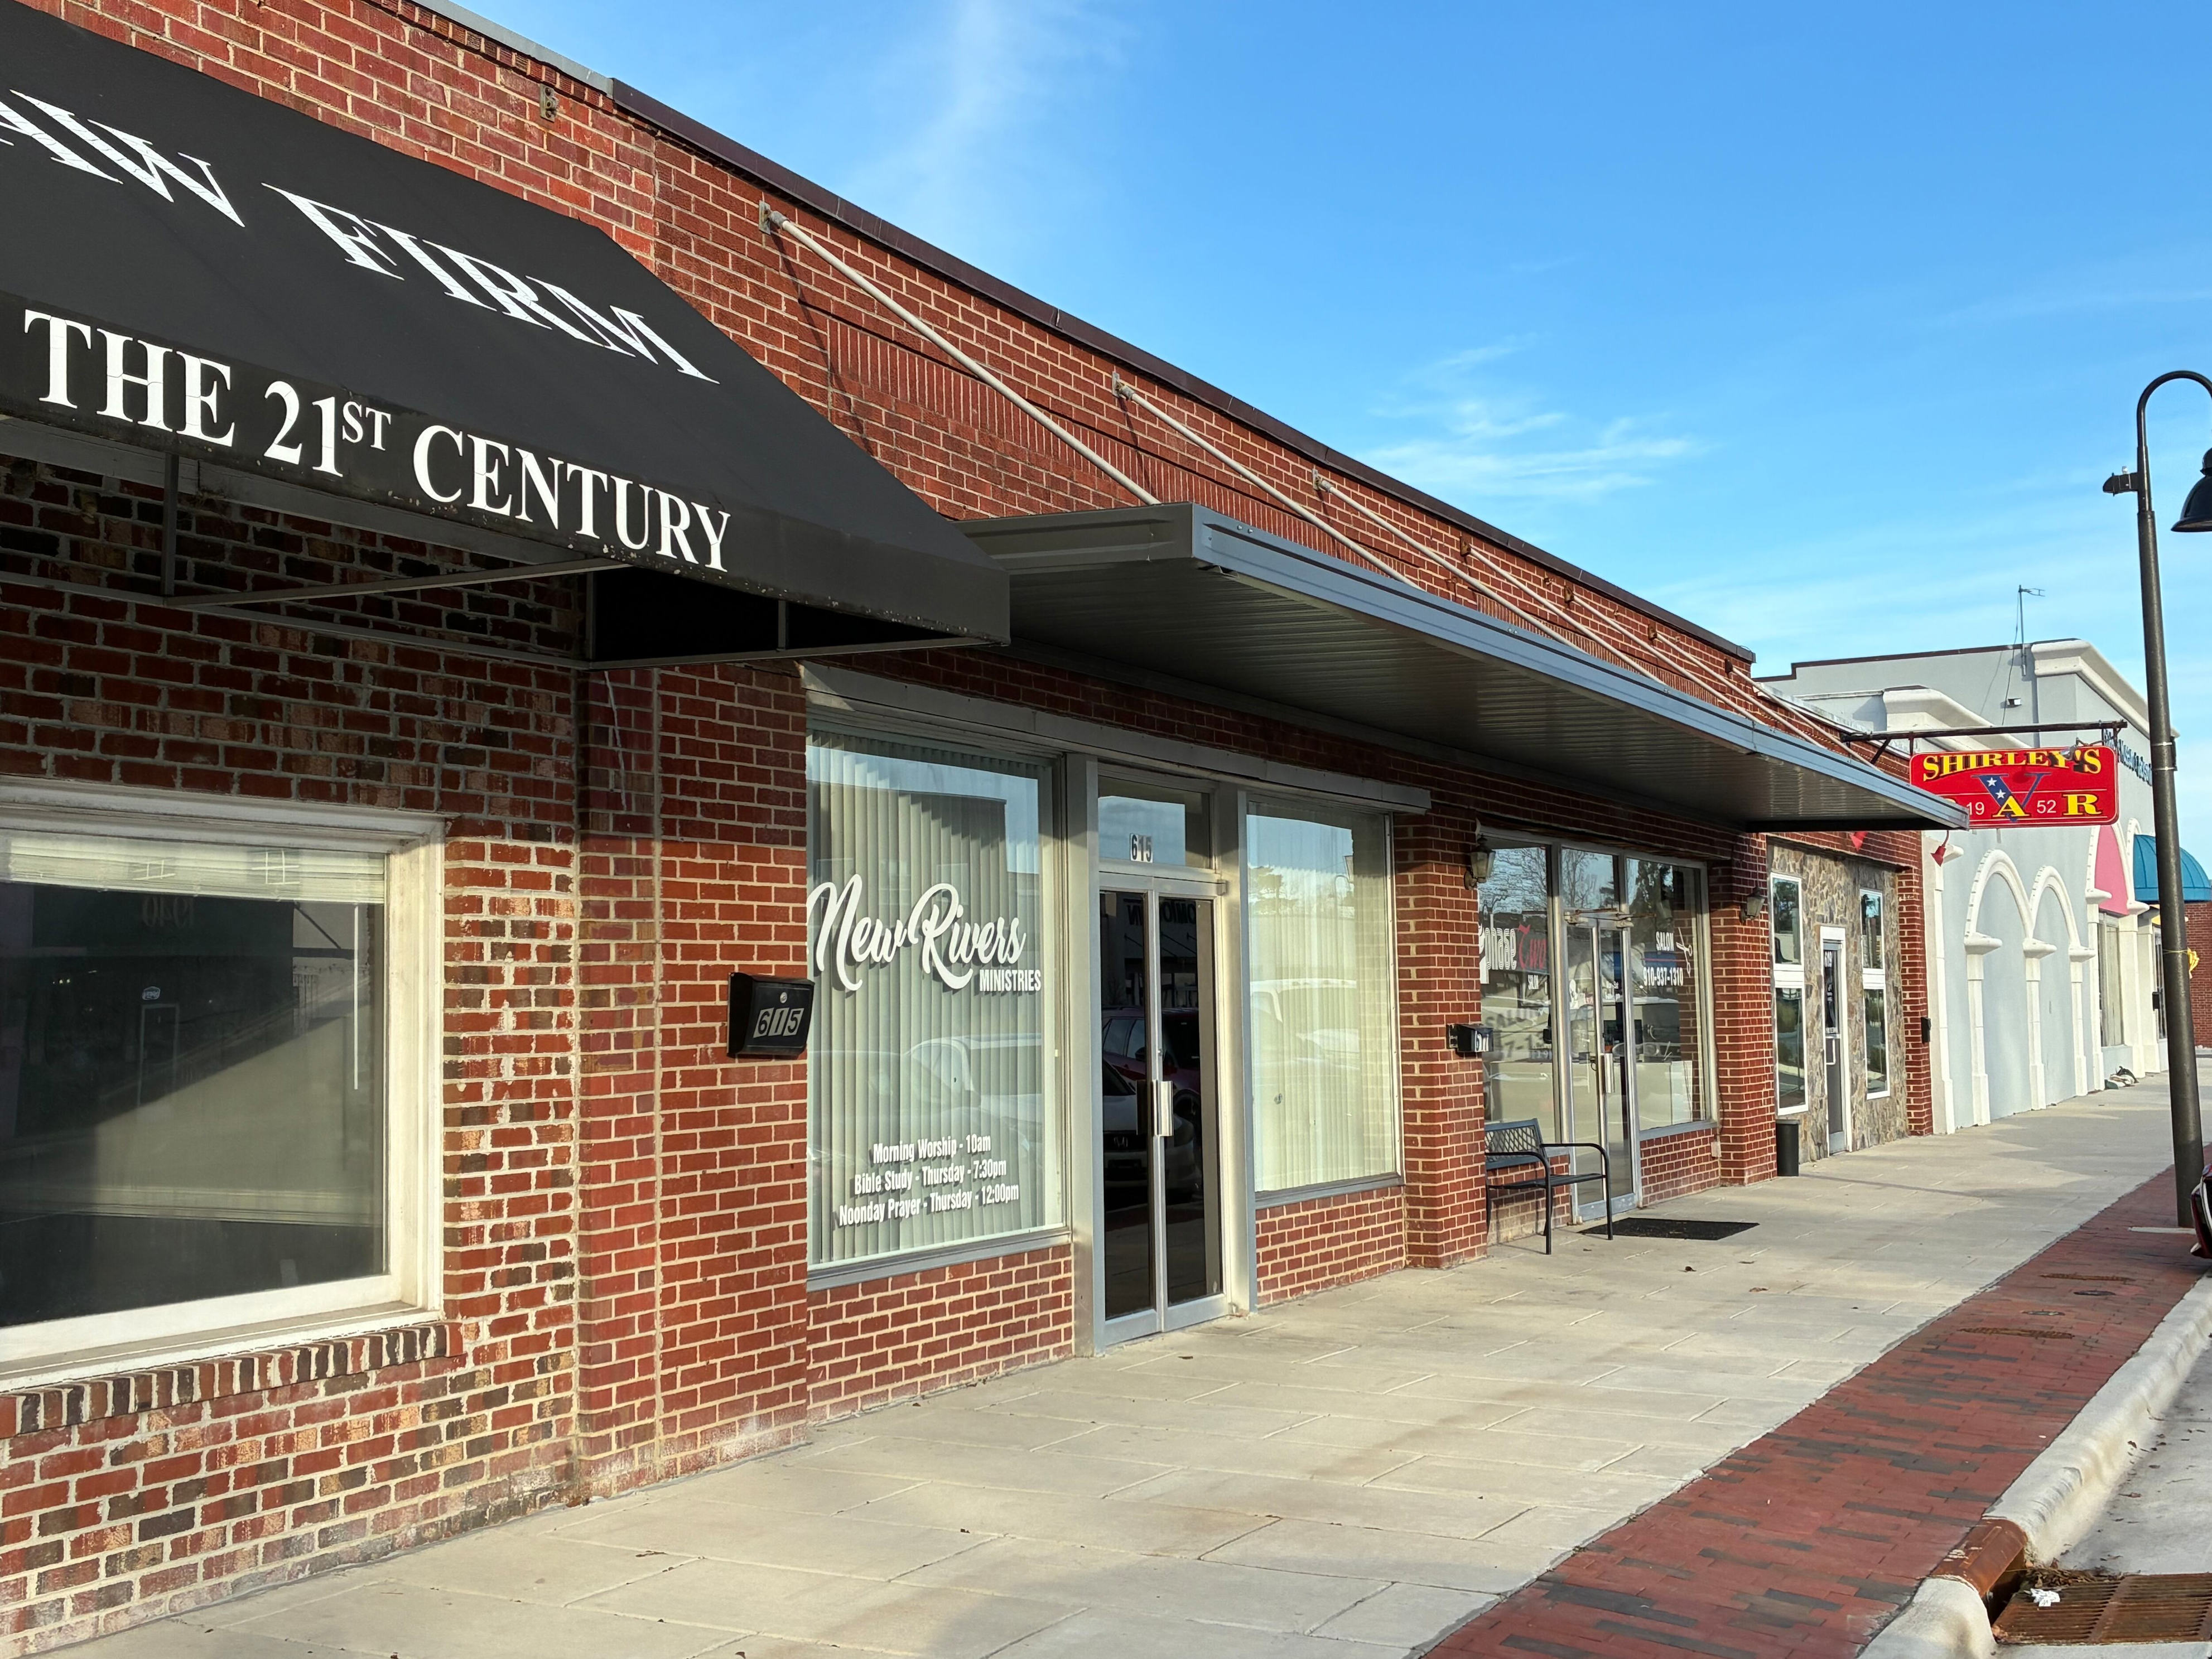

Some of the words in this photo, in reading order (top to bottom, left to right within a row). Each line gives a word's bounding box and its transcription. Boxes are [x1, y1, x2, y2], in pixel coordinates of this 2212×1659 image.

[261, 182, 721, 384] FIRM
[24, 309, 235, 447] THE
[263, 380, 392, 478] 21ST
[413, 424, 731, 572] CENTURY
[1922, 749, 2102, 782] SHIRLEY'S
[1967, 802, 1985, 816] 19
[2036, 799, 2057, 814] 52
[1130, 834, 1153, 862] 615
[807, 874, 908, 991] New
[908, 883, 1027, 990] Rivers
[1655, 931, 1675, 952] SALON
[980, 968, 1042, 992] MINISTRIES
[1643, 967, 1684, 987] 910-937-1310
[756, 1009, 802, 1035] 615
[873, 1141, 915, 1164] Morning
[918, 1136, 957, 1159] Worship
[966, 1134, 991, 1154] 10am
[854, 1172, 882, 1195] Bible
[884, 1168, 913, 1191] Study
[922, 1163, 965, 1186] Thursday
[973, 1159, 1007, 1180] 7:30pm
[838, 1200, 885, 1227] Noonday
[888, 1198, 921, 1219] Prayer
[930, 1189, 972, 1213] Thursday
[981, 1183, 1020, 1204] 12:00pm
